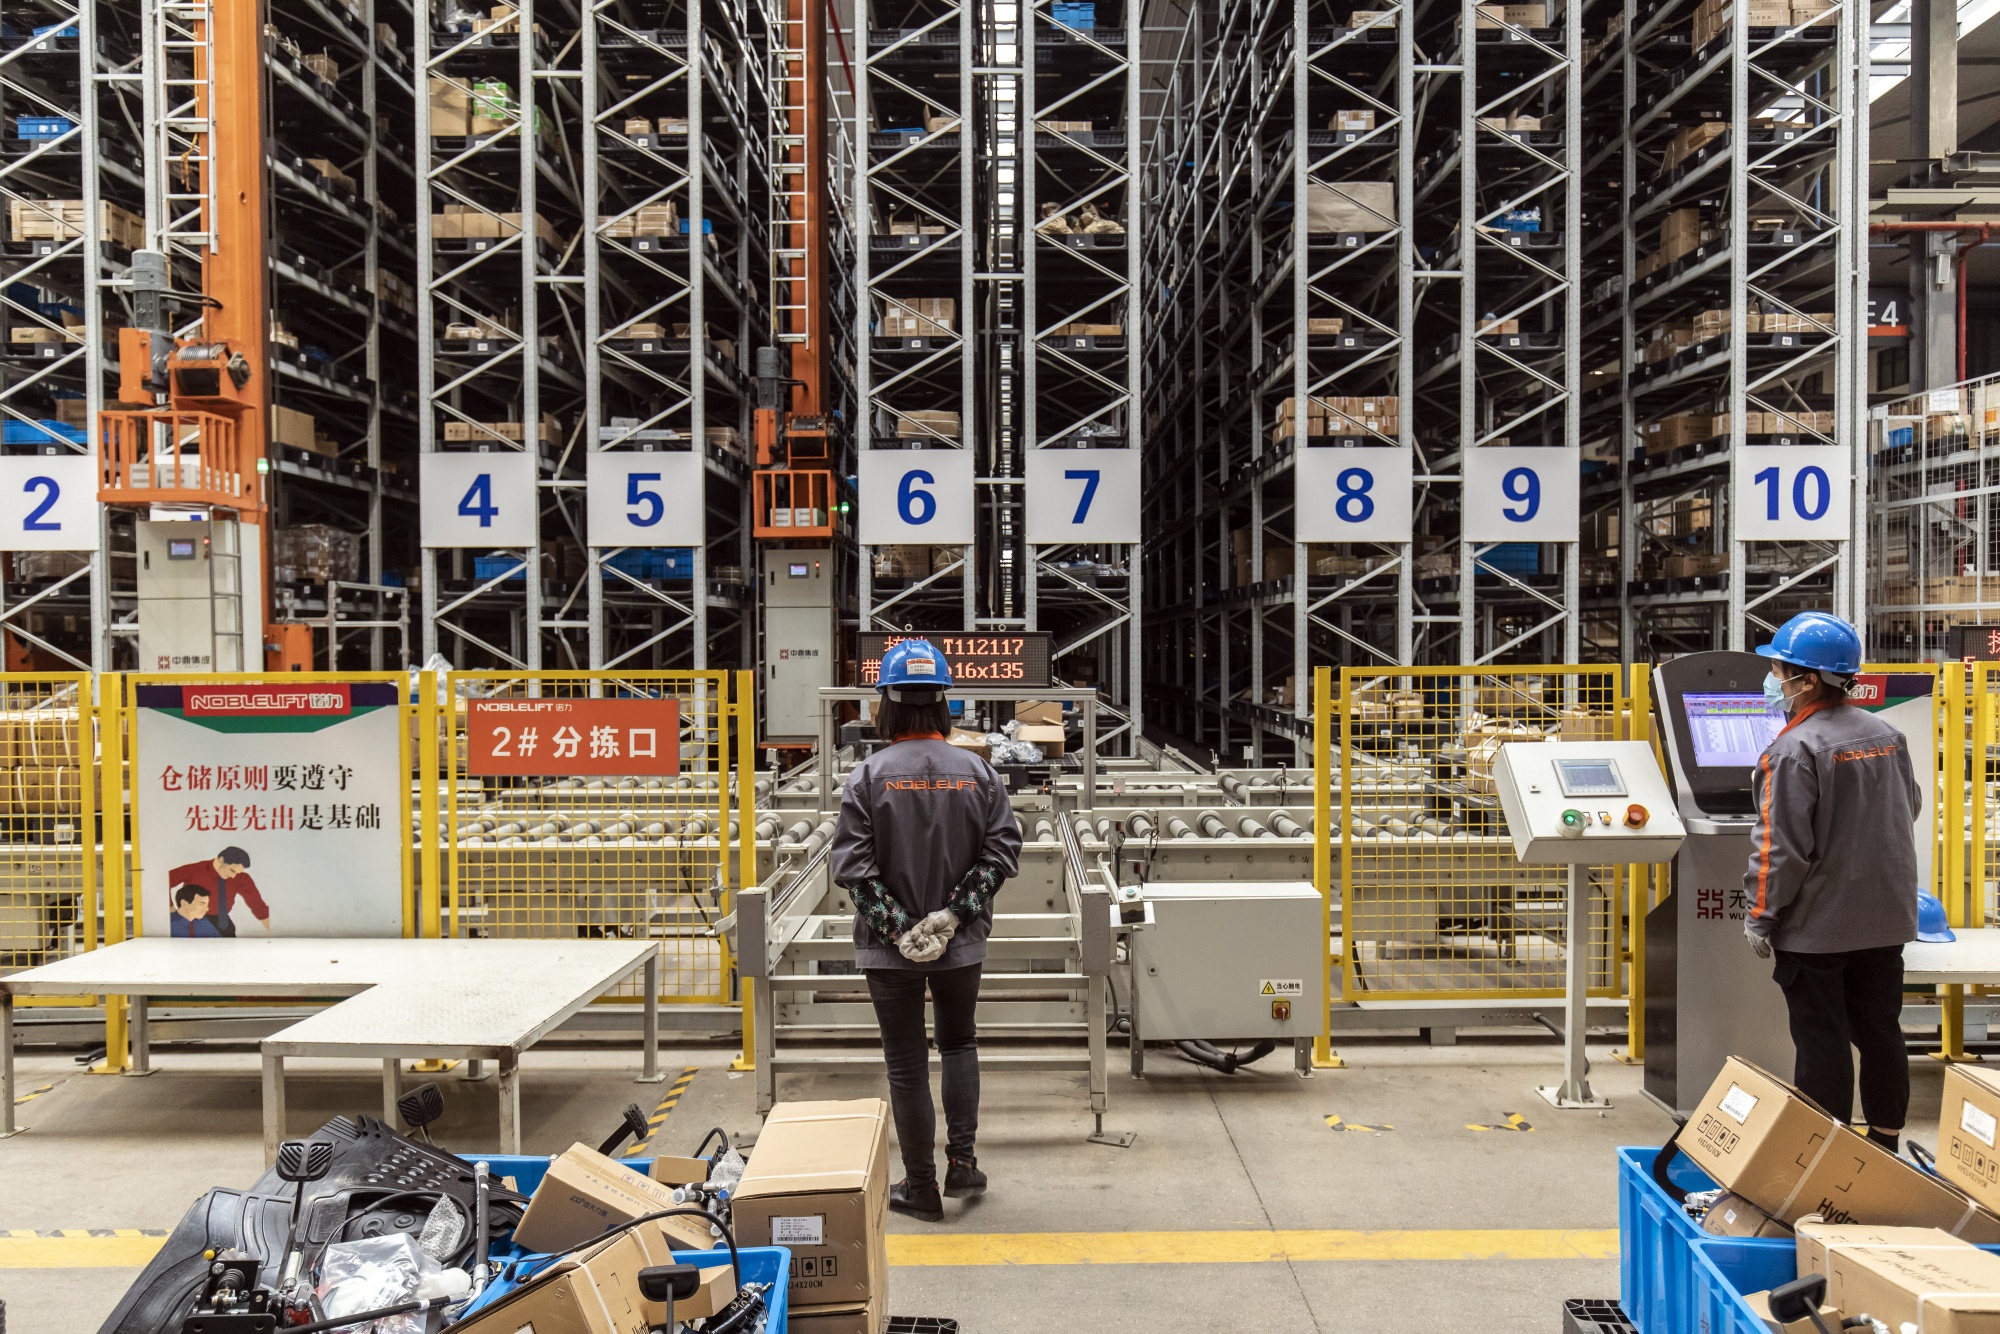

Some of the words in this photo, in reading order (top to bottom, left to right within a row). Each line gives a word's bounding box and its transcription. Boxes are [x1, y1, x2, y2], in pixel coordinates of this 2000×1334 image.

[22, 476, 62, 531] 2
[457, 474, 499, 527] 4
[626, 473, 665, 527] 5
[897, 469, 937, 525] 6
[1064, 470, 1100, 524] 7
[1335, 467, 1375, 523] 8
[1502, 467, 1541, 523] 9
[1754, 465, 1831, 521] 10
[943, 638, 1024, 655] T112117
[191, 694, 307, 710] NOBLELIFT
[476, 703, 553, 712] NOBLELIFT
[491, 726, 539, 757] 2#
[552, 725, 657, 759] 分拣口
[1833, 744, 1898, 764] NOBLELIFT
[159, 764, 354, 792] 仓储原则要遵守
[885, 780, 977, 792] NOBLELIFT
[184, 803, 381, 832] 先进先出是基础
[1729, 912, 1746, 920] WU
